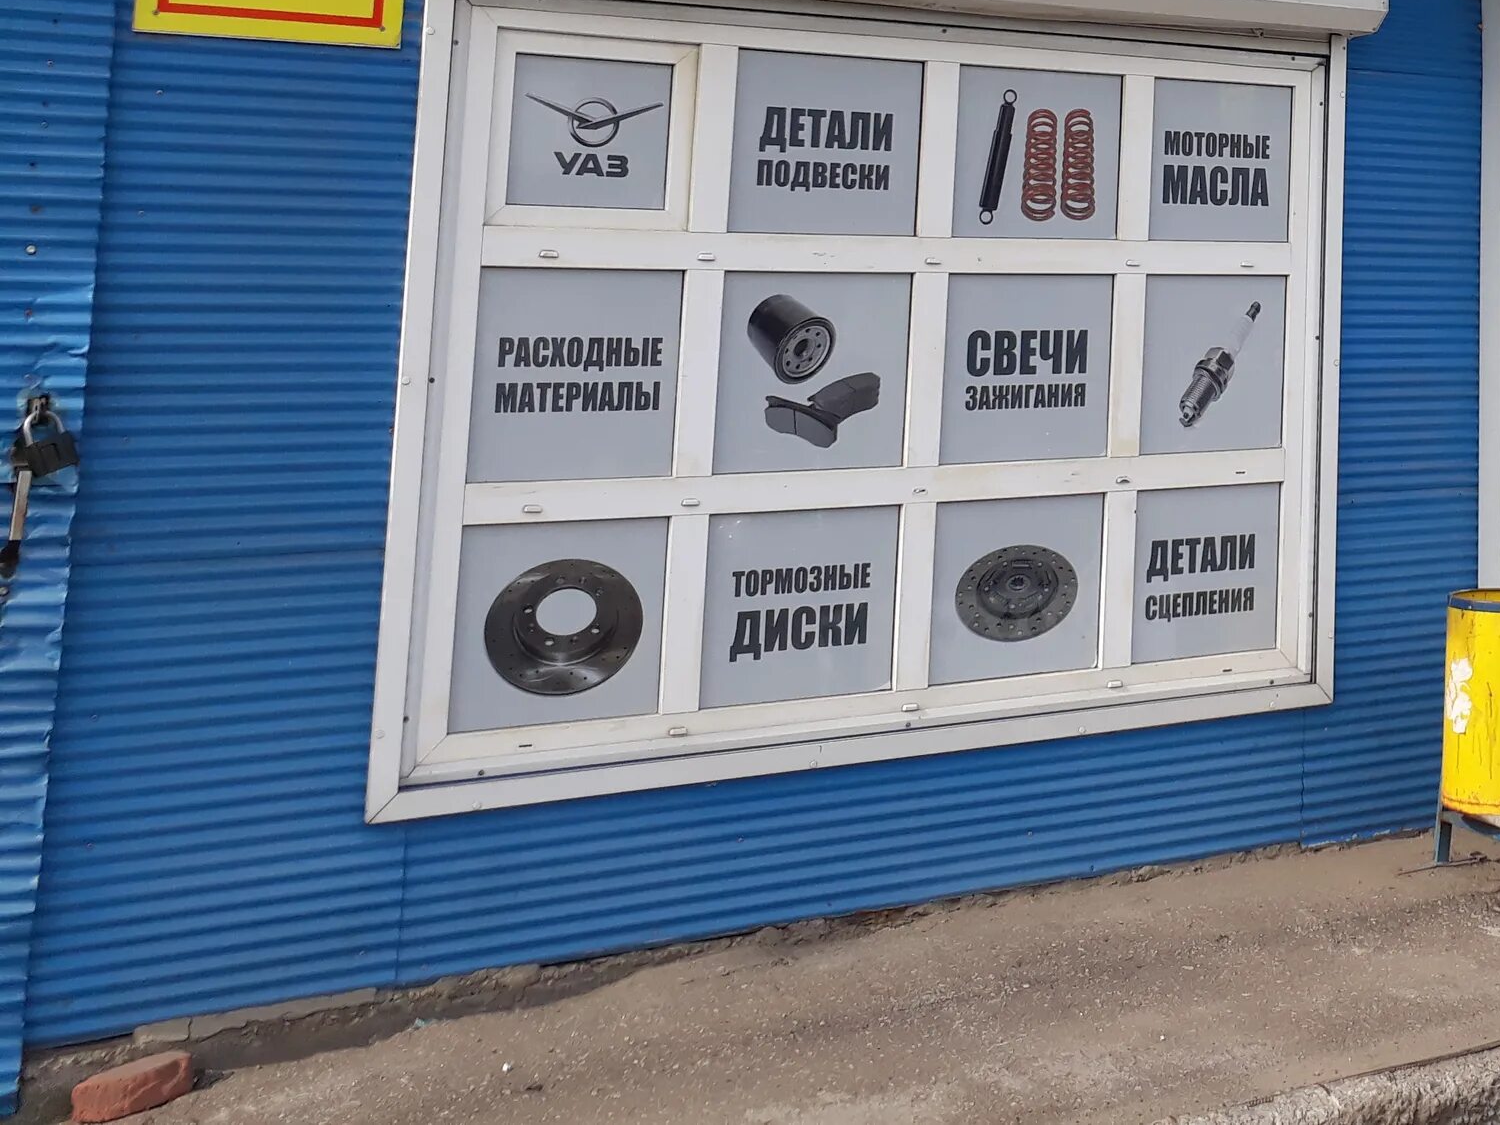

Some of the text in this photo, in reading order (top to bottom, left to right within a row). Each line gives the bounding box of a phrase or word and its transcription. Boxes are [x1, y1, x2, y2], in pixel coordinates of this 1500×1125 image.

[759, 106, 893, 154] ДЕТАЛИ
[1164, 130, 1270, 159] МОТОРНЫЕ
[553, 151, 629, 178] УАЗ
[756, 159, 890, 193] ПОДВЕСКИ
[1162, 165, 1269, 207] МАСЛА
[498, 336, 663, 372] РАСХОДНЫЕ
[966, 329, 1089, 377] СВЕЧИ
[494, 381, 661, 414] МАТЕРИАЛЫ
[964, 382, 1086, 412] ЗАЖИГАНИЯ
[1146, 533, 1256, 583] ДЕТАЛИ
[732, 563, 871, 598] ТОРМОЗНЫЕ
[1144, 586, 1255, 622] СЦЕПЛЕНИЯ
[729, 602, 869, 662] ДИСКИ
